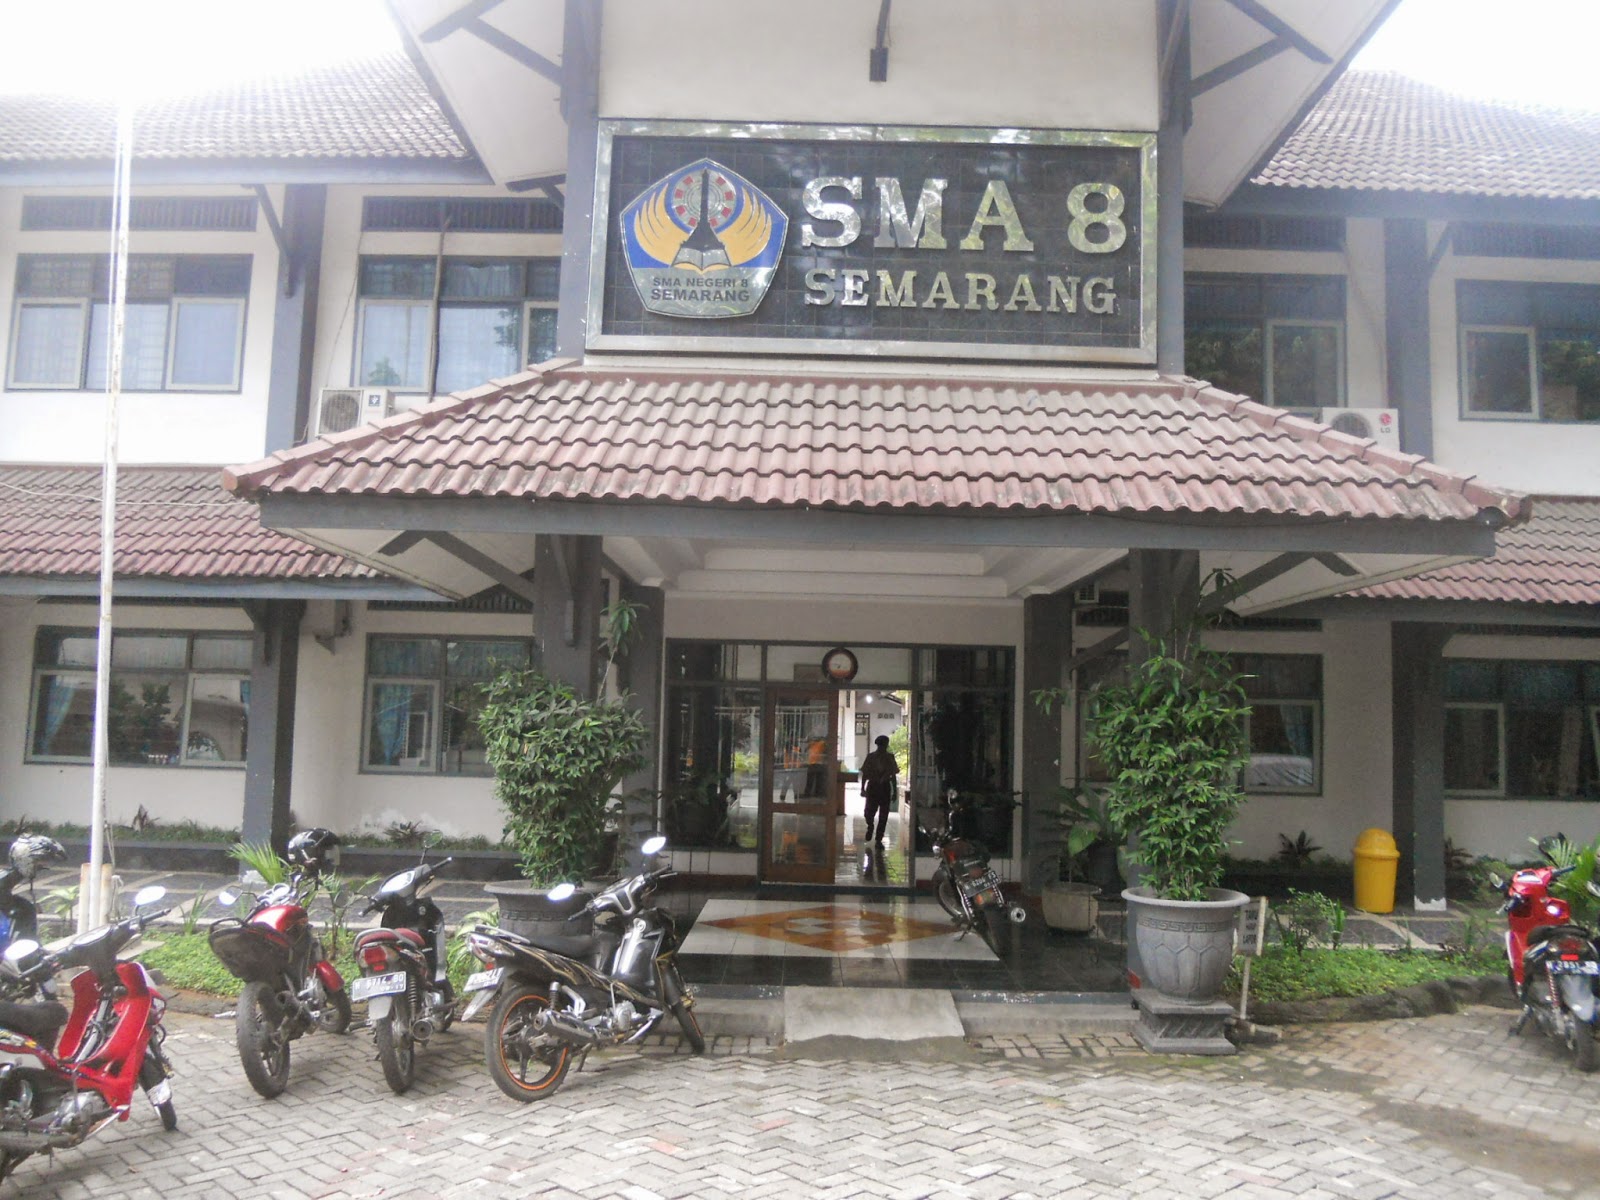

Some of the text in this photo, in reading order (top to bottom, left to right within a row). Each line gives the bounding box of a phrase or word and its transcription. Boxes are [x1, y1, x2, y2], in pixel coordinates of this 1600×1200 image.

[801, 176, 1128, 254] SMA 8
[651, 288, 750, 302] SEMARANG
[653, 278, 749, 288] SMA NEGERI 8
[804, 268, 1117, 315] SEMARANG
